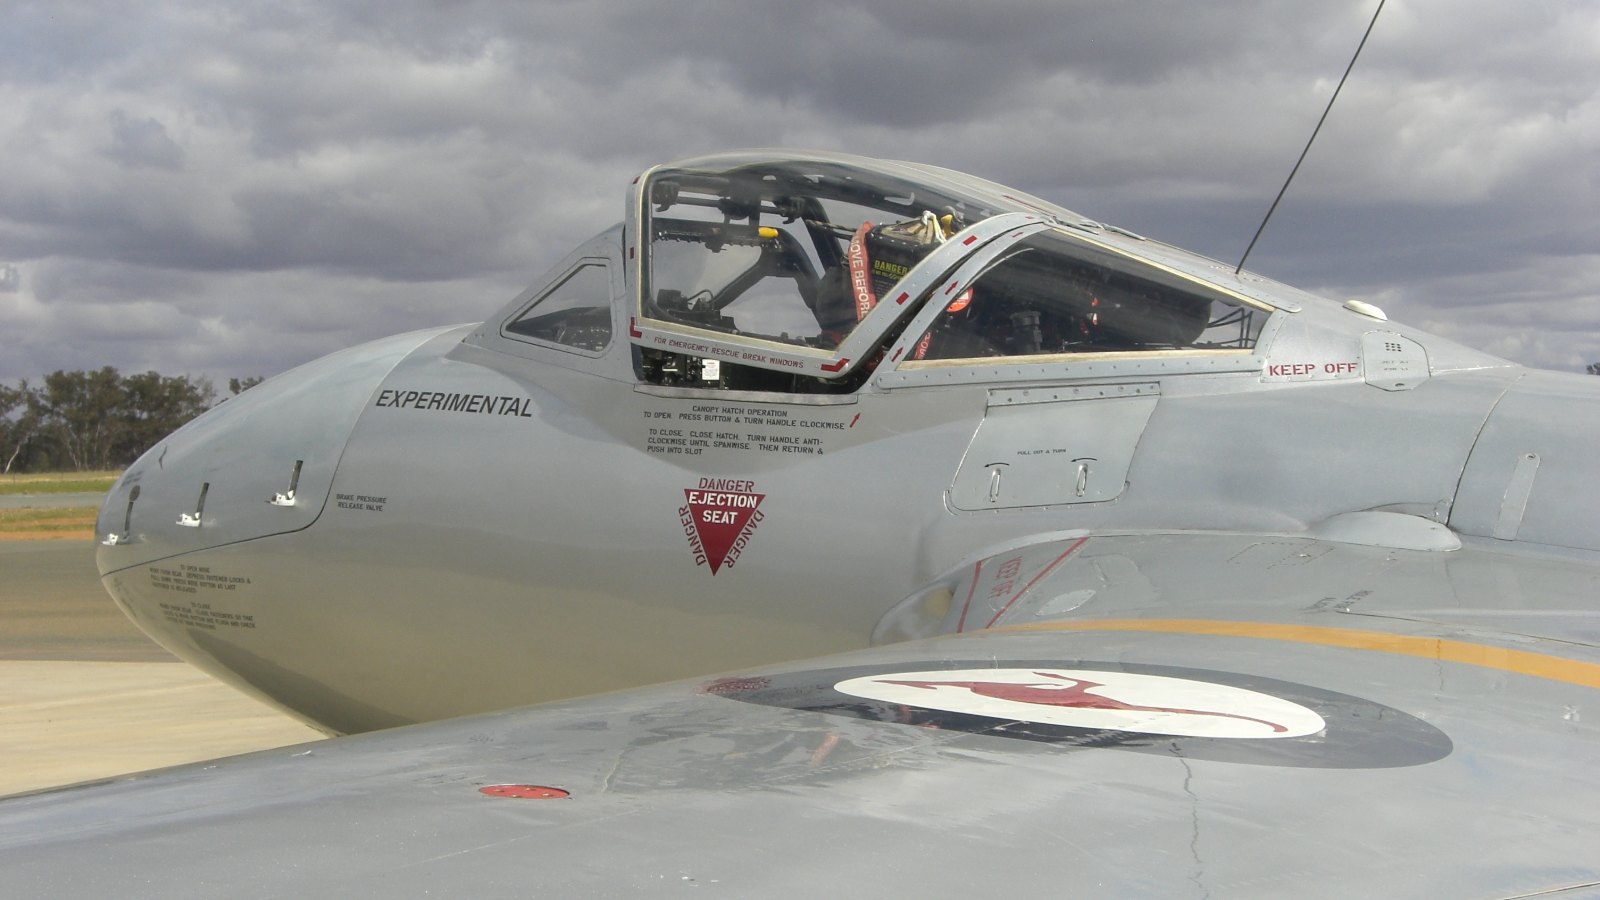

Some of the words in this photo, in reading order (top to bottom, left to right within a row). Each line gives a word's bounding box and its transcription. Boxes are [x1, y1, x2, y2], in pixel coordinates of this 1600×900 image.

[874, 260, 908, 275] DANGER
[669, 340, 709, 352] EMERGENCY
[711, 347, 740, 358] RESCUE
[742, 352, 766, 362] BREAK
[769, 357, 804, 368] WINDOWS
[1269, 364, 1315, 376] KEEP
[1324, 362, 1358, 374] OFF
[376, 390, 532, 417] EXPERIMENTAL
[747, 409, 788, 417] OPERATION
[766, 418, 797, 426] HANDLE
[800, 420, 845, 430] CLOCKWISE
[648, 437, 687, 446] CLOCKWISE
[782, 446, 814, 454] RETURN
[770, 436, 800, 444] HANDLE
[698, 477, 755, 492] DANGER
[356, 495, 386, 503] PRESSURE
[689, 492, 758, 508] EJECTION
[702, 510, 738, 524] SEAT
[678, 504, 706, 566] DANGER
[724, 510, 765, 568] DANGER
